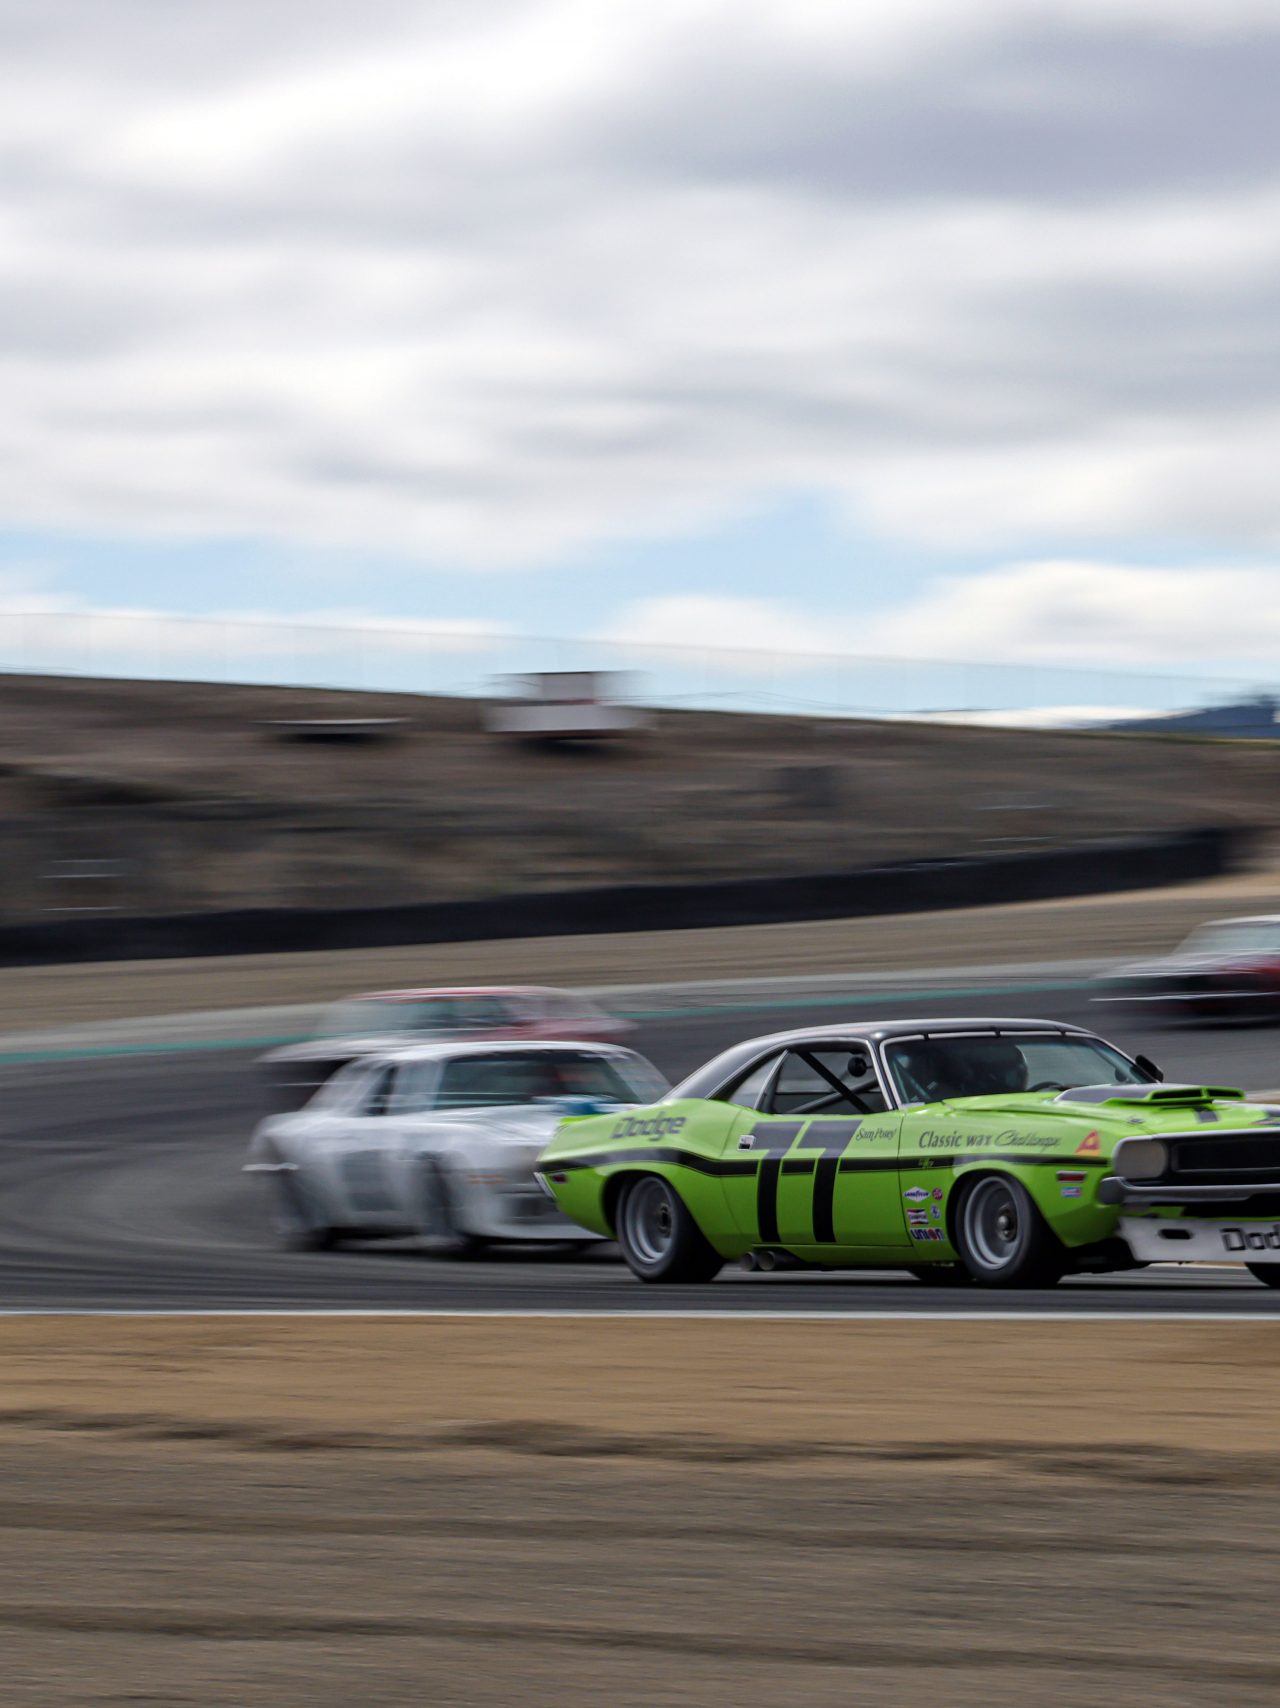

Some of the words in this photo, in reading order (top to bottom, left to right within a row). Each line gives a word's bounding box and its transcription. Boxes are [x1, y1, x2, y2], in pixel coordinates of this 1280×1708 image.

[612, 1111, 686, 1141] Dodge
[919, 1131, 962, 1148] Classic
[966, 1134, 992, 1147] wax
[750, 1119, 862, 1243] 77
